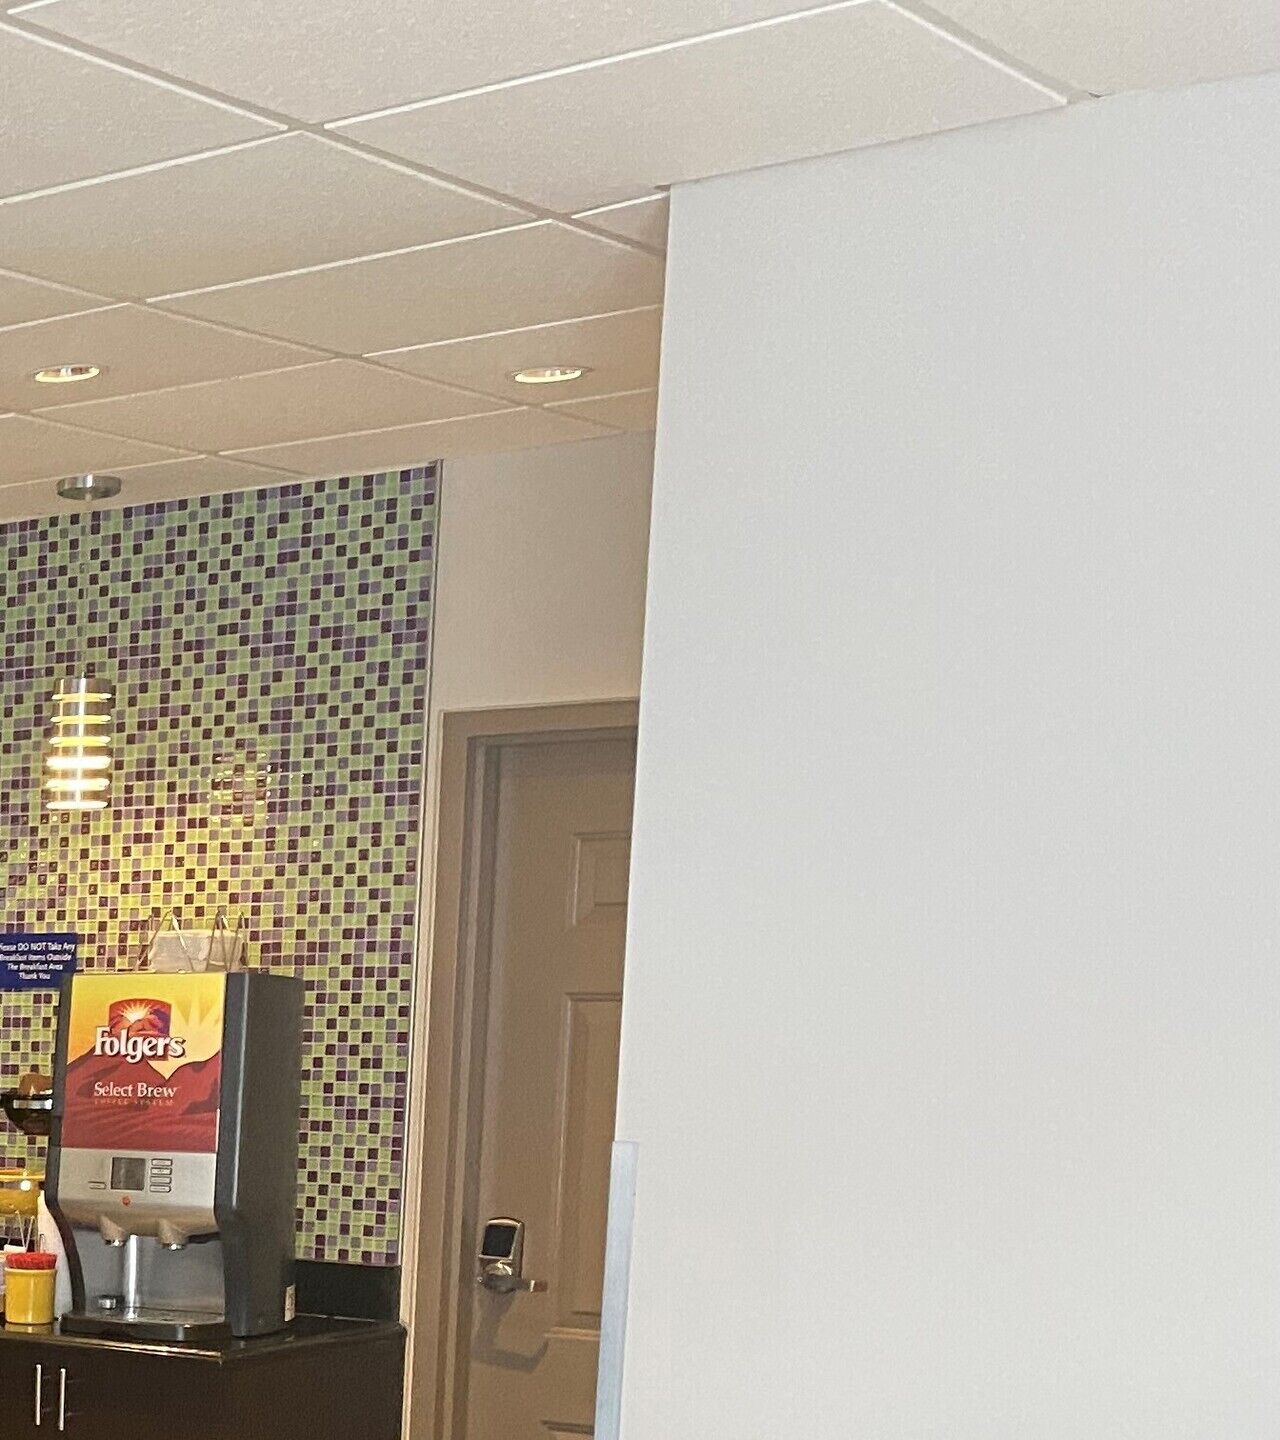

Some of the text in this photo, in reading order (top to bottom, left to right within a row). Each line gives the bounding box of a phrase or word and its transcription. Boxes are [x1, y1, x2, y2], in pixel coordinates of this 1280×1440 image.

[17, 942, 30, 951] DO
[30, 942, 46, 951] NOT
[47, 942, 62, 951] Take
[62, 942, 75, 953] Any
[0, 953, 28, 961] Breakfast
[7, 962, 63, 971] The Breakfast Area
[18, 972, 51, 980] Thank You
[92, 1025, 186, 1064] Folgers
[93, 1081, 177, 1098] Select Brew
